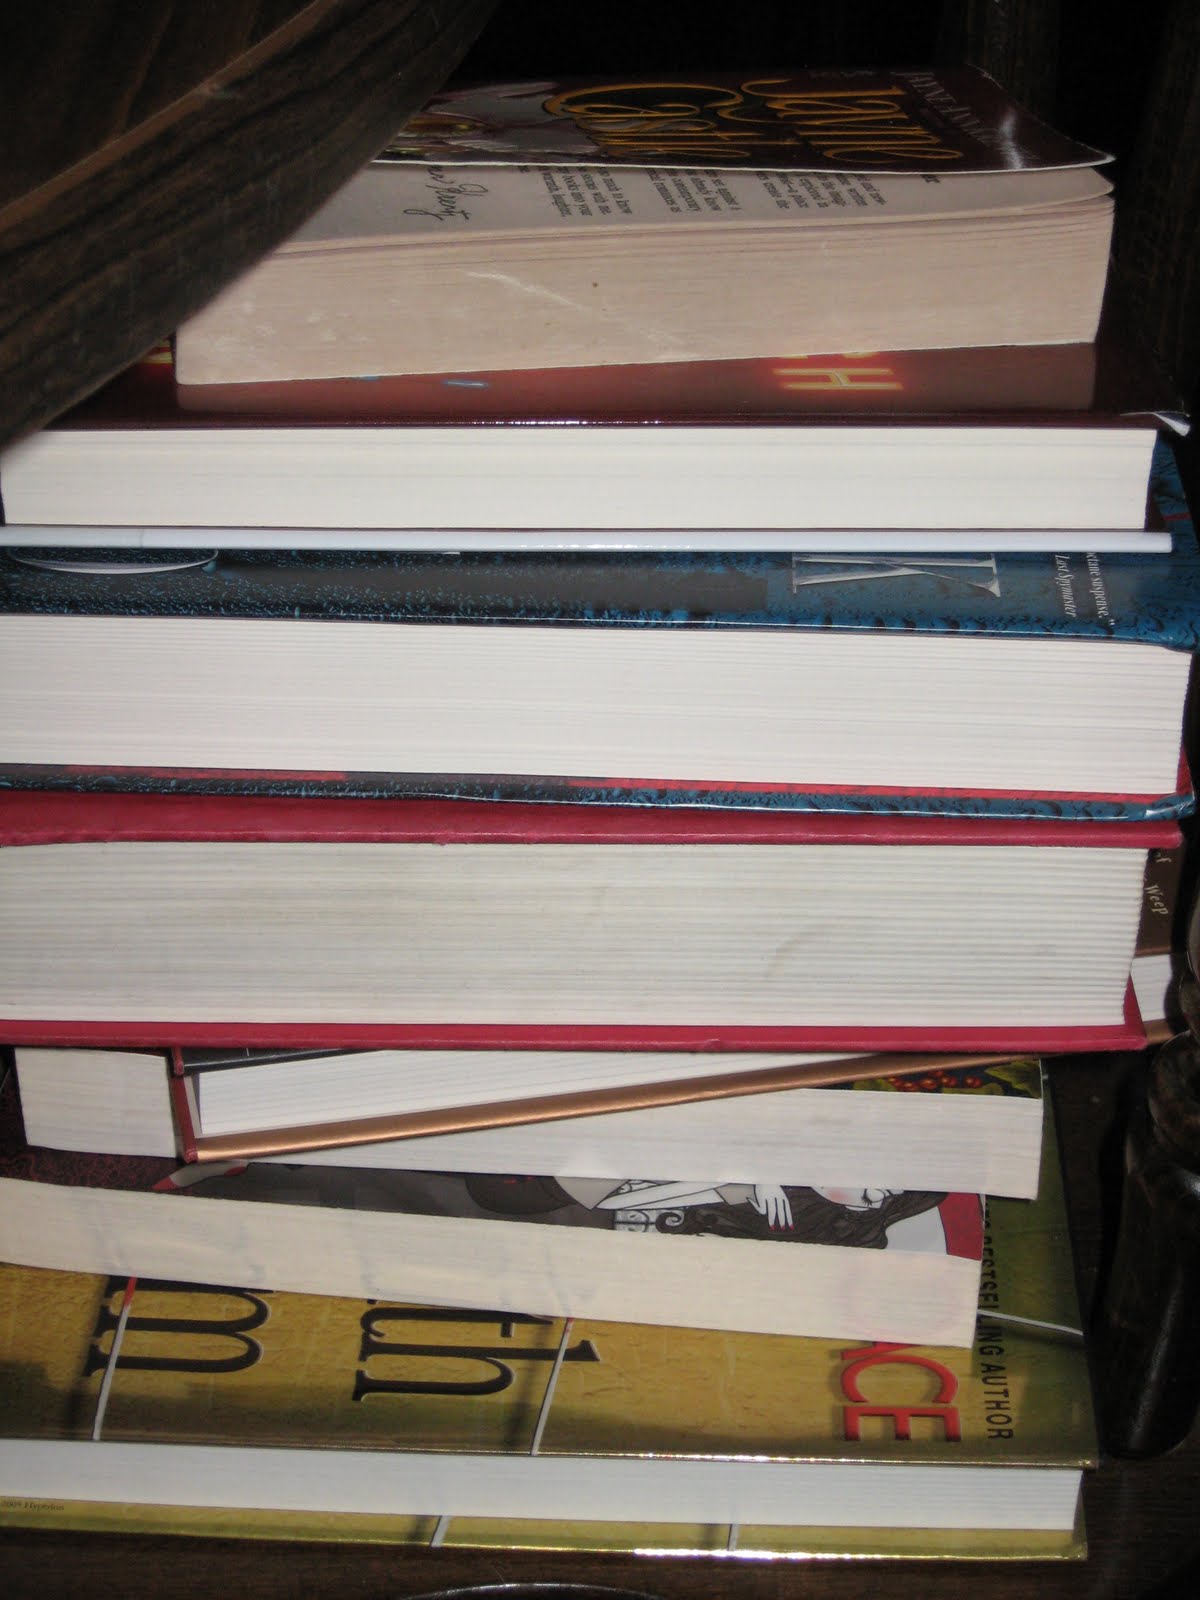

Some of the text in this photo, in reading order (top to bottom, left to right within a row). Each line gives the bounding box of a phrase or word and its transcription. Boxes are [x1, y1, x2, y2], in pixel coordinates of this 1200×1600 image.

[543, 82, 753, 160] Castle
[717, 79, 966, 163] Jayne
[1054, 554, 1077, 618] Last Spymaster
[1143, 884, 1169, 915] Weep
[981, 1362, 1014, 1440] AUTHOR
